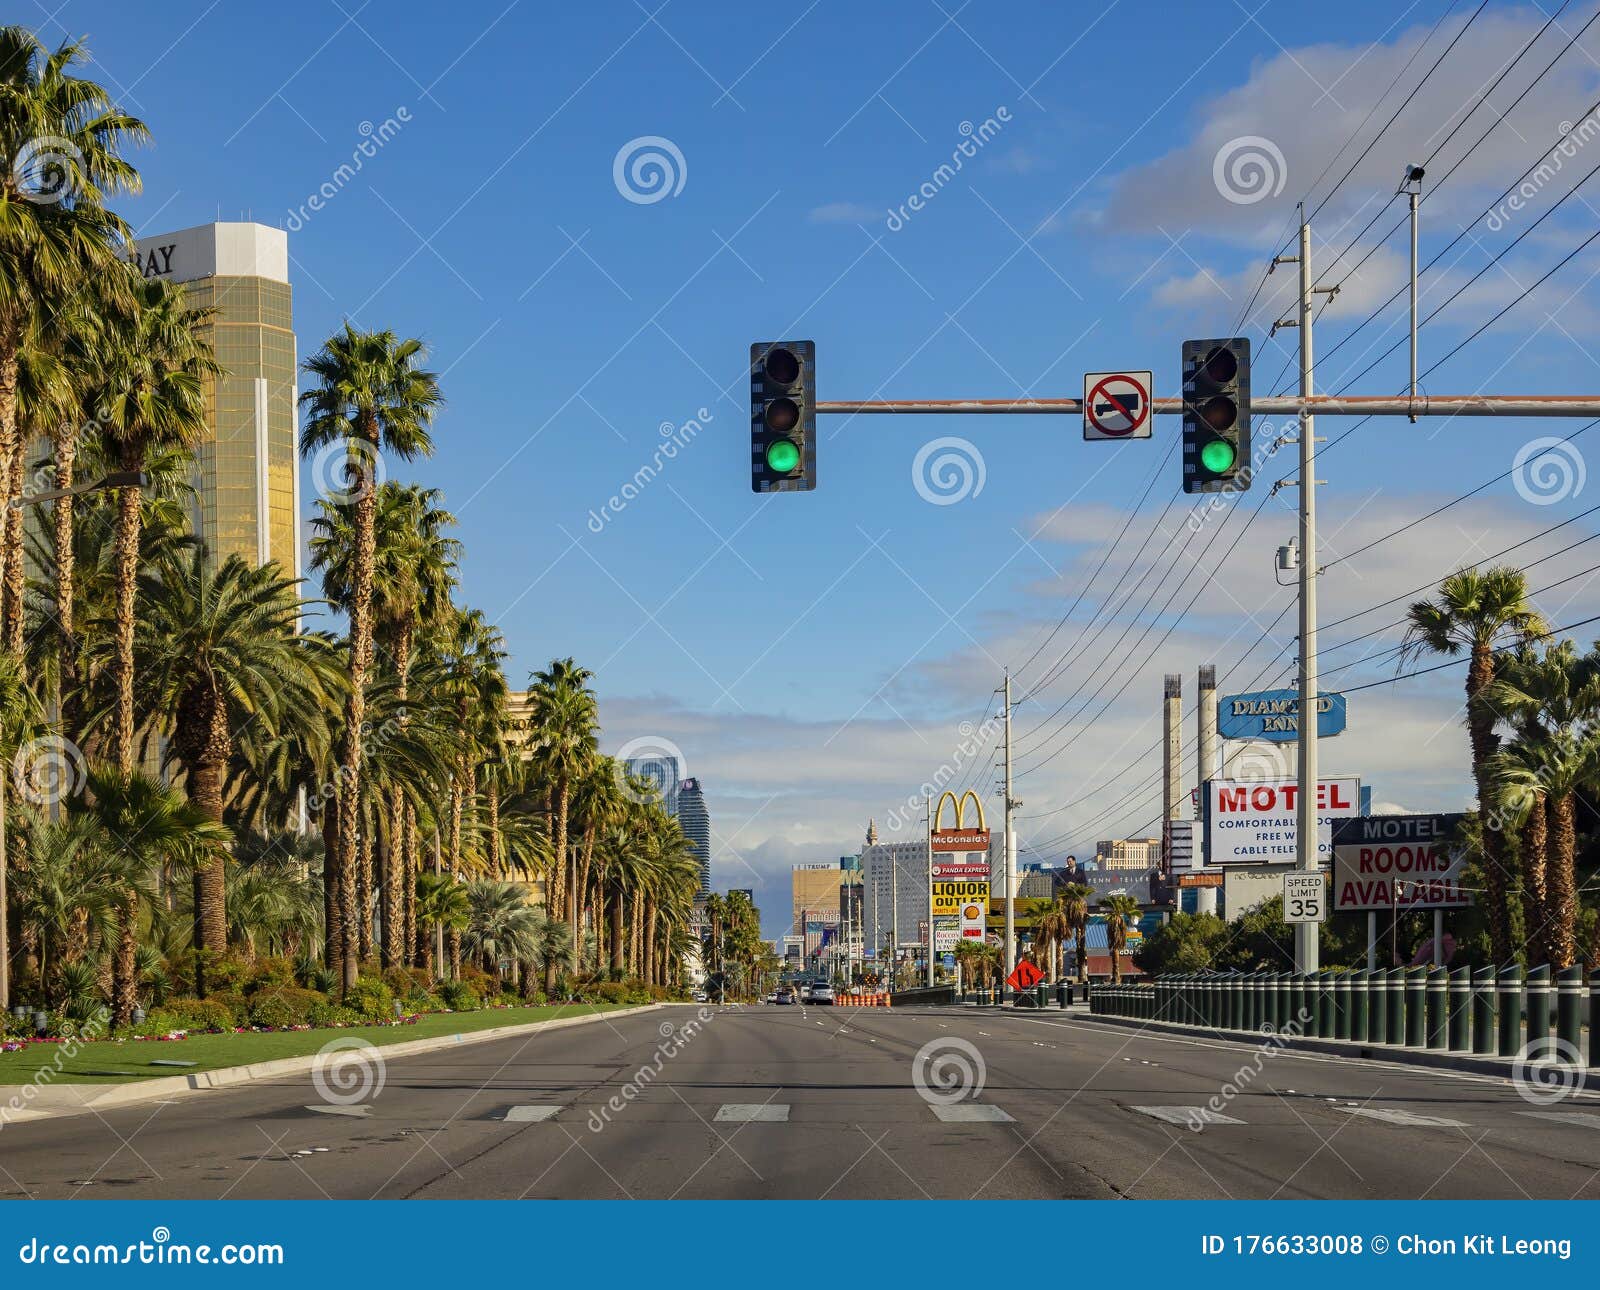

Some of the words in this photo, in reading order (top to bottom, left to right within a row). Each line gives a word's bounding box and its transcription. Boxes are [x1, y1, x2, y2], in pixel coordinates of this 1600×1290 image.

[1232, 697, 1333, 715] DIAMD
[1219, 817, 1298, 828] COMFORTABL
[1363, 819, 1442, 839] MOTEL
[1256, 832, 1281, 841] FREE
[1233, 845, 1267, 855] CABLE
[1287, 878, 1322, 887] SPEED
[932, 883, 987, 896] LIQUOR
[1290, 888, 1318, 897] LIMIT
[1290, 899, 1319, 917] 35
